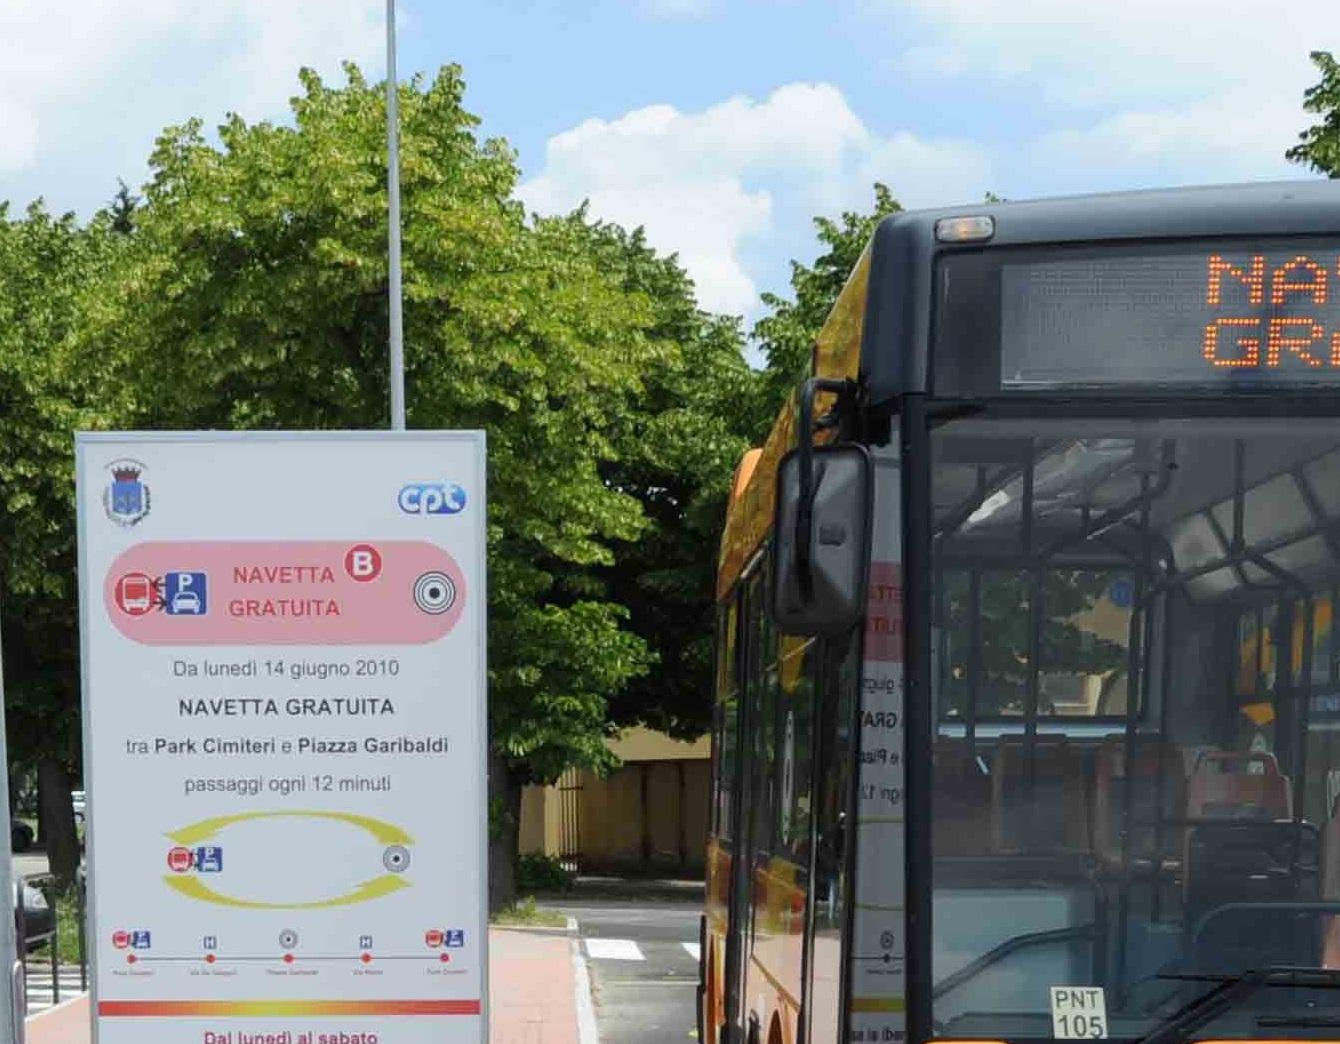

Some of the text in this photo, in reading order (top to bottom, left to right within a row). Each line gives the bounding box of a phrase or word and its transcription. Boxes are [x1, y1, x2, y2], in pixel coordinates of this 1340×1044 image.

[352, 551, 374, 575] B
[178, 574, 194, 591] P
[233, 566, 335, 584] NAVETTA
[229, 600, 340, 617] GRATUITA
[174, 659, 400, 680] Da lunedì 14 giugno 2010
[179, 698, 394, 716] NAVETTA GRATUITA
[126, 737, 449, 754] tra Park Cimiteri e Piazza Garibaldi
[184, 775, 391, 796] passaggi ogni 12 minuti
[1055, 991, 1098, 1009] PNT
[1058, 1014, 1103, 1038] 105
